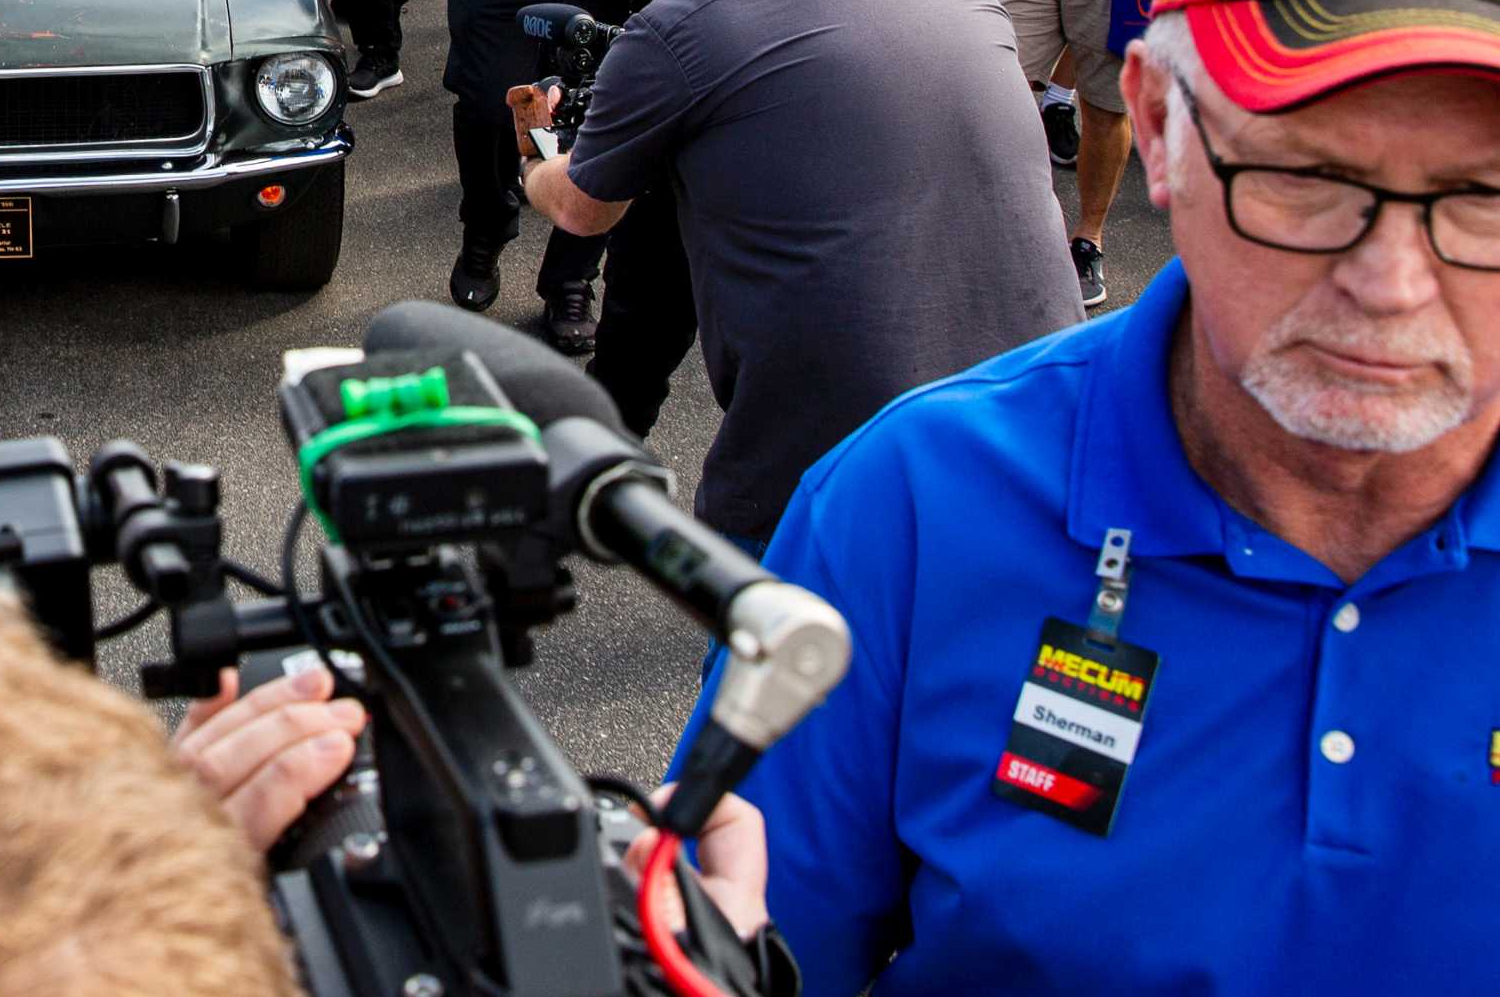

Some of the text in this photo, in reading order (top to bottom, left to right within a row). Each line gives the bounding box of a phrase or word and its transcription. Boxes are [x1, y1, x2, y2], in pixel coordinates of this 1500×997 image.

[1038, 644, 1145, 701] MECUM
[1033, 704, 1117, 749] Sherman
[1008, 760, 1056, 792] STAFF
